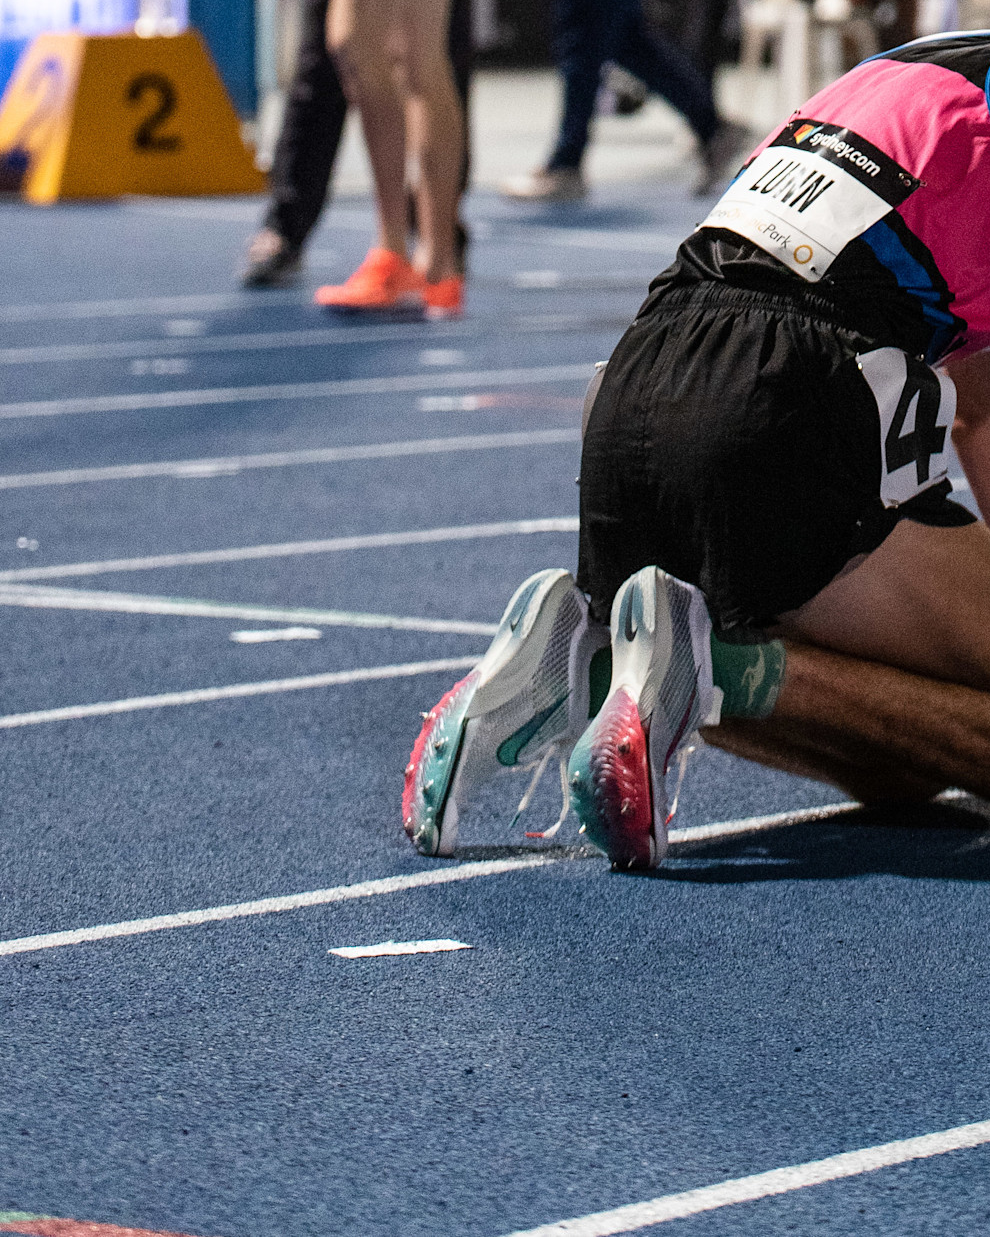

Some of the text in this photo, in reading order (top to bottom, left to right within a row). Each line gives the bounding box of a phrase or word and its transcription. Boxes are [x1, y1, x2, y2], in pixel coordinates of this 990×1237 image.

[126, 71, 182, 152] 2
[749, 158, 835, 214] LUNN
[808, 130, 882, 178] sydney.com
[884, 352, 947, 486] 4
